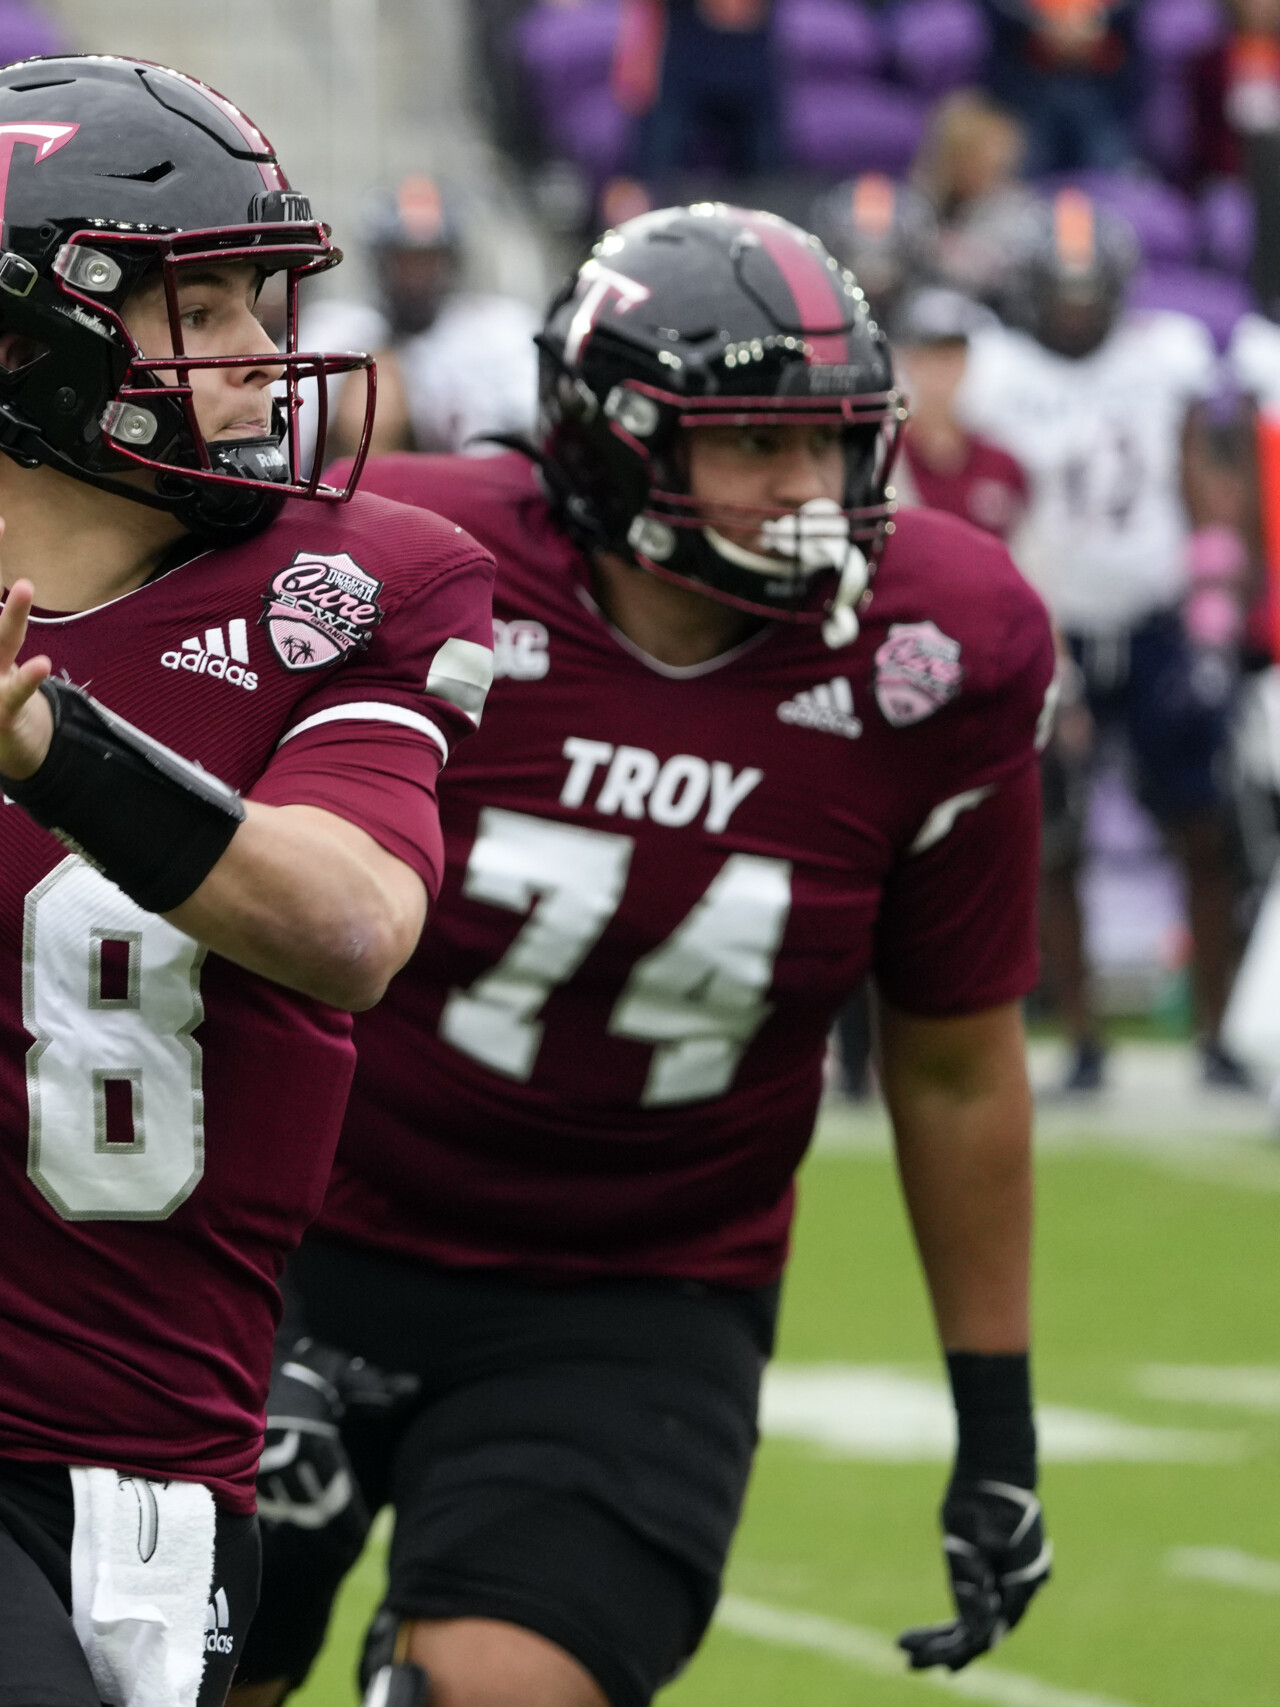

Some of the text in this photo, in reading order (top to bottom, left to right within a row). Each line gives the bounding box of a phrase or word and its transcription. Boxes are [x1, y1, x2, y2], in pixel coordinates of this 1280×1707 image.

[271, 563, 377, 625] Cure
[324, 568, 378, 602] DULUTH
[275, 590, 363, 640] BOWL
[309, 616, 351, 647] ORLANDO
[160, 649, 259, 691] adidas
[559, 736, 765, 835] TROY
[438, 806, 793, 1109] 74
